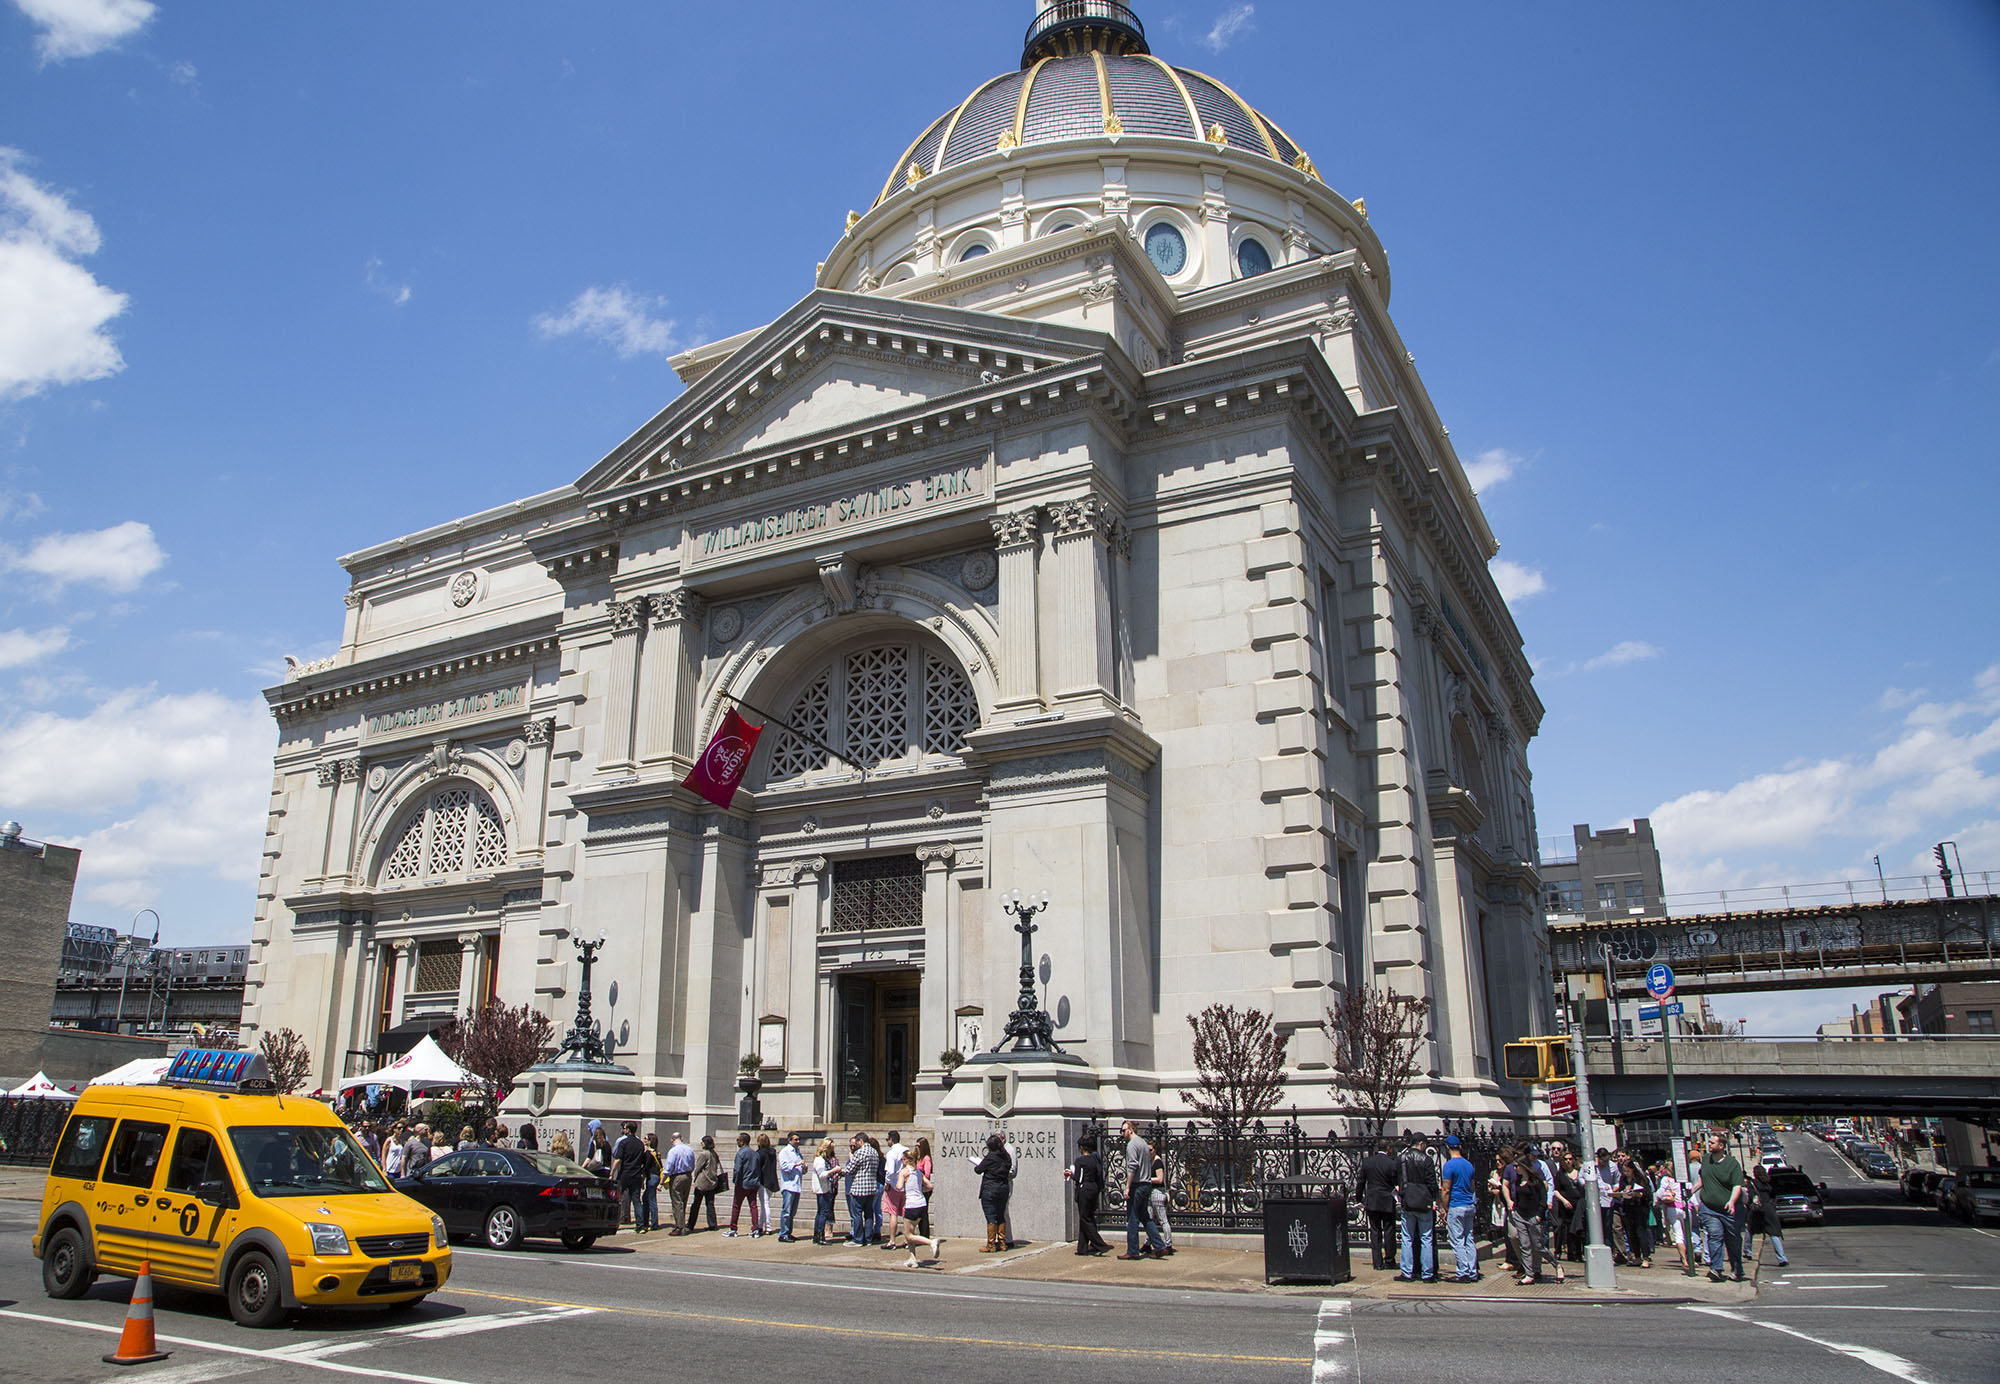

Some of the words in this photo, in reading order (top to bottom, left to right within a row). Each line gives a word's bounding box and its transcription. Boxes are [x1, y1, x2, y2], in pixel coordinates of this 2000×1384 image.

[704, 504, 827, 554] WILLIAMSBURGH
[839, 482, 911, 522] SAVINGS
[925, 467, 971, 501] BANK
[372, 704, 444, 734] WILLIAMSBURGH
[448, 693, 489, 718] SAVINGS
[493, 686, 520, 708] BANK
[249, 1080, 267, 1088] 4C62
[988, 1120, 1008, 1129] THE
[942, 1132, 1056, 1144] WILLIABURGH
